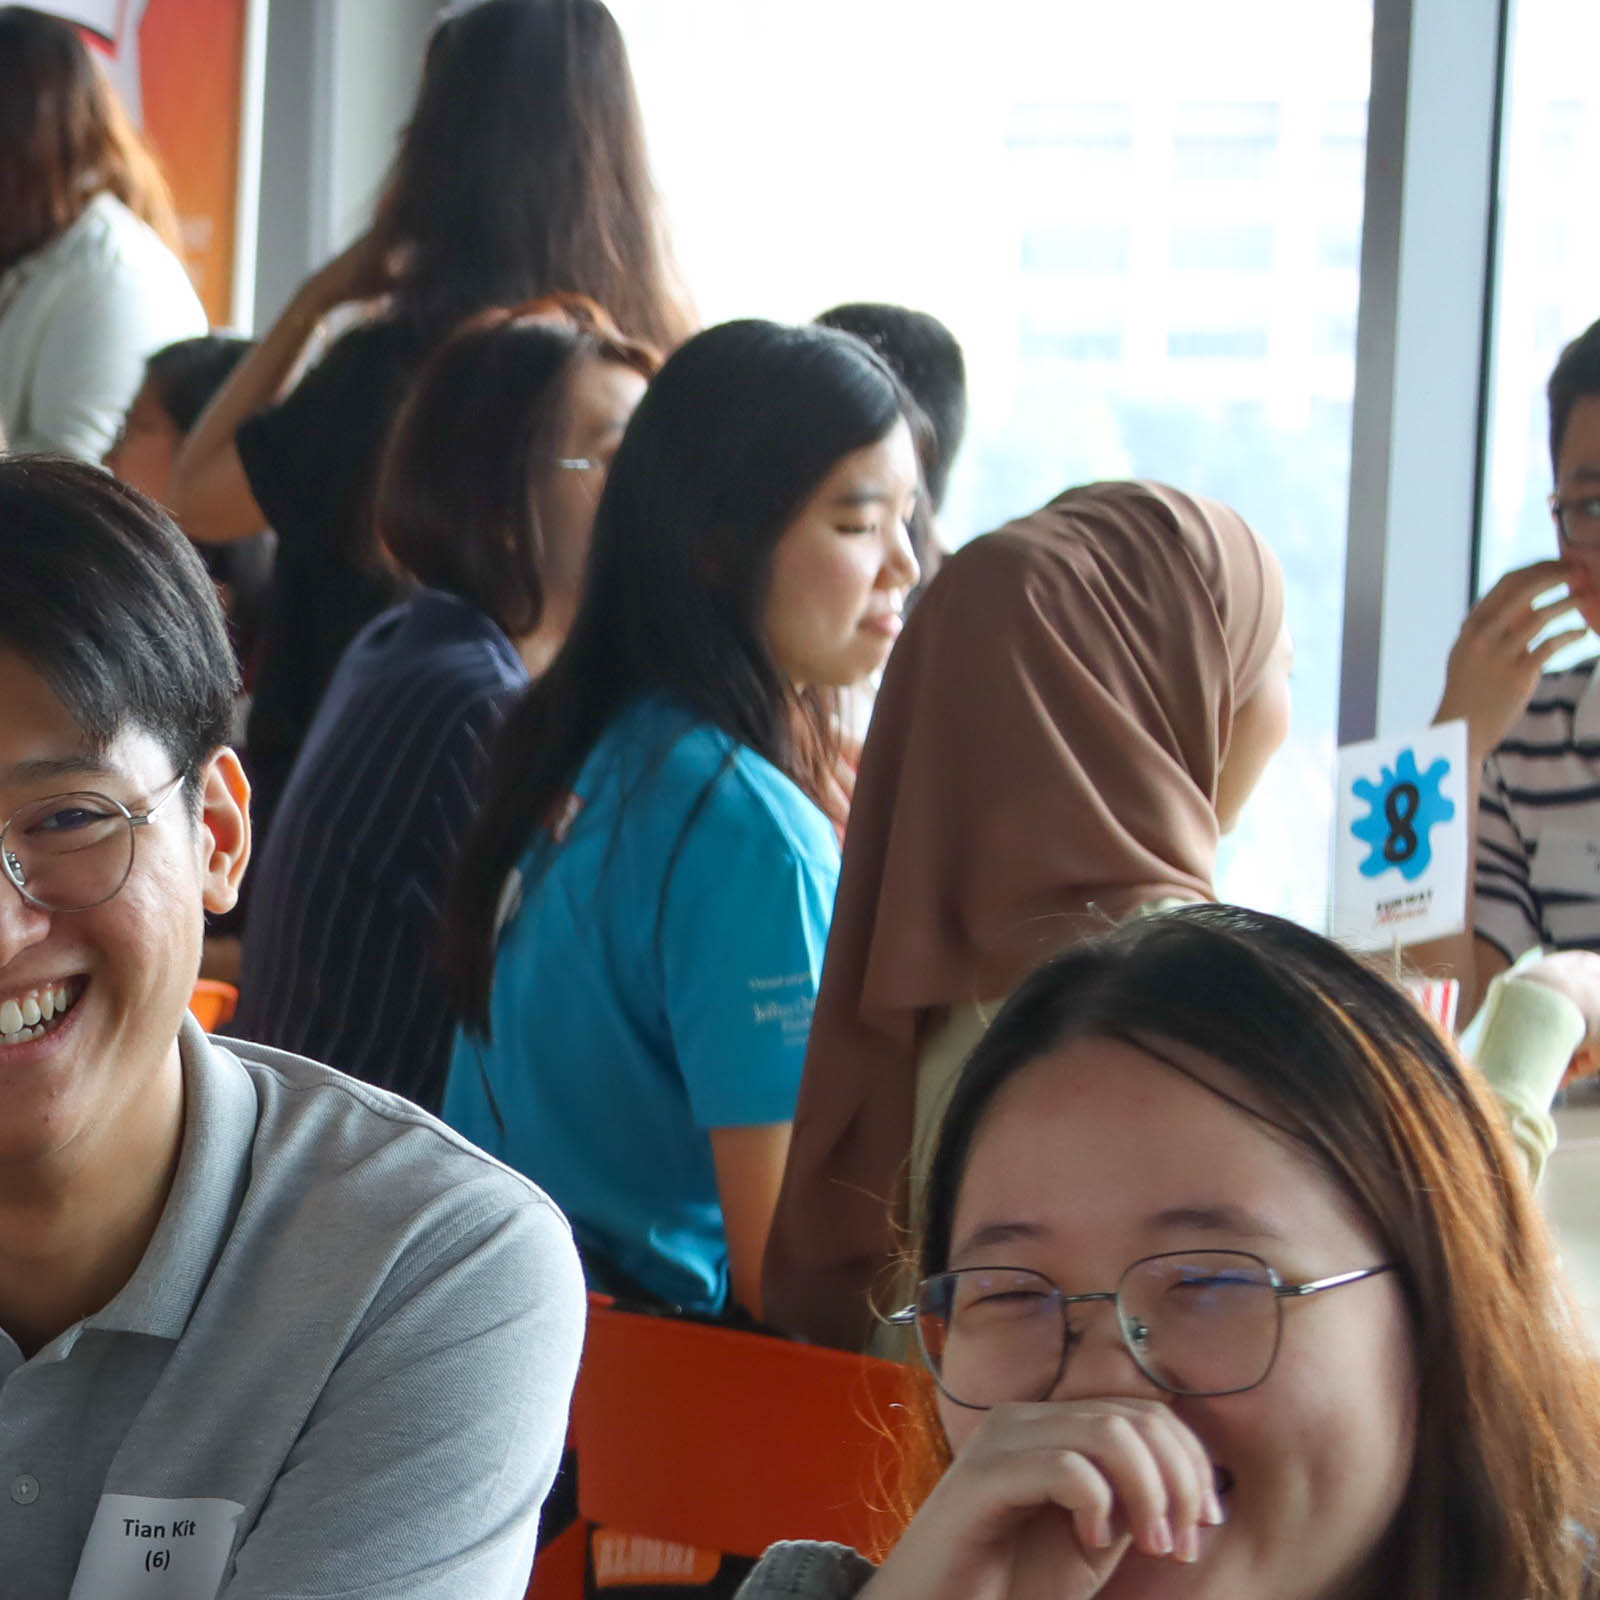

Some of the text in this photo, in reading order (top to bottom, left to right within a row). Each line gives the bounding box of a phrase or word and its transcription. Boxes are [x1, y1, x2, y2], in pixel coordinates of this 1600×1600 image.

[1384, 781, 1419, 862] 8
[122, 1518, 197, 1538] Tian Kit
[145, 1549, 170, 1573] (6)
